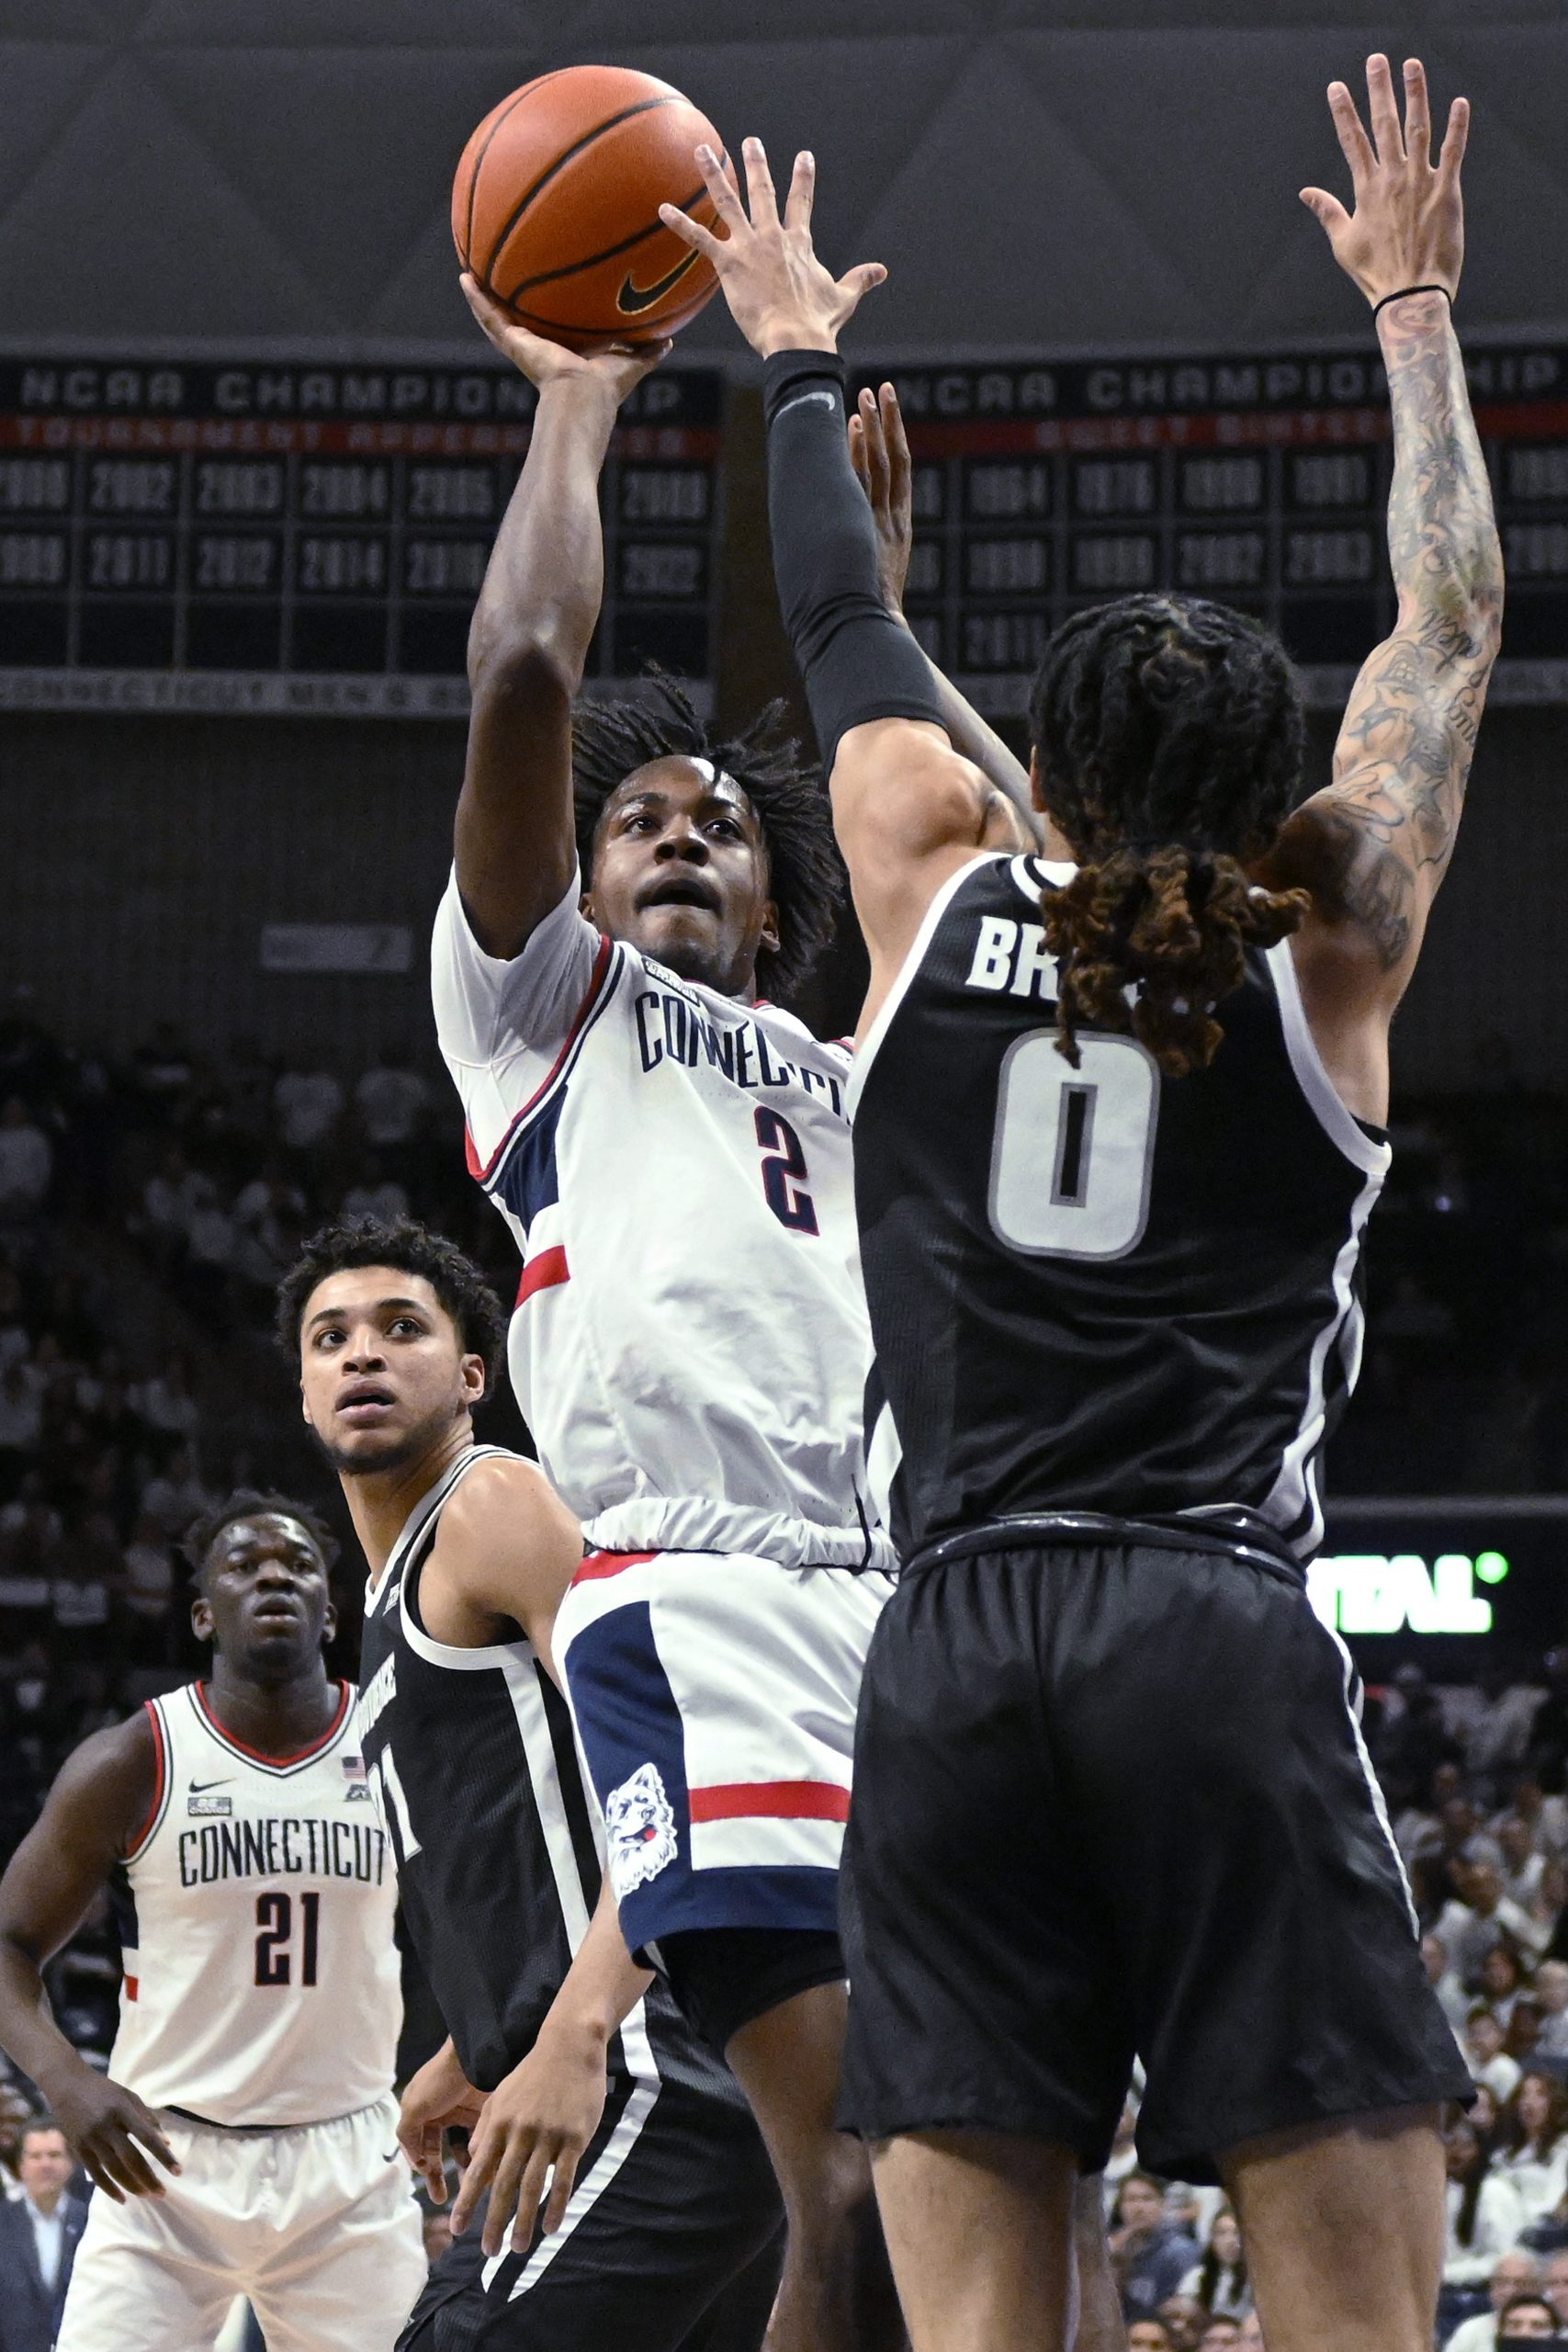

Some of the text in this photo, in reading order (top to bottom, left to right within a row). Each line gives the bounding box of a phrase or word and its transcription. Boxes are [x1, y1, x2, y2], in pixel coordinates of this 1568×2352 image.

[20, 368, 681, 413] NCAA CHAMPIONIP
[753, 1105, 820, 1237] 2
[987, 1026, 1161, 1261] 0
[178, 1817, 386, 1888] CONNECTICUT
[254, 1891, 320, 1987] 21
